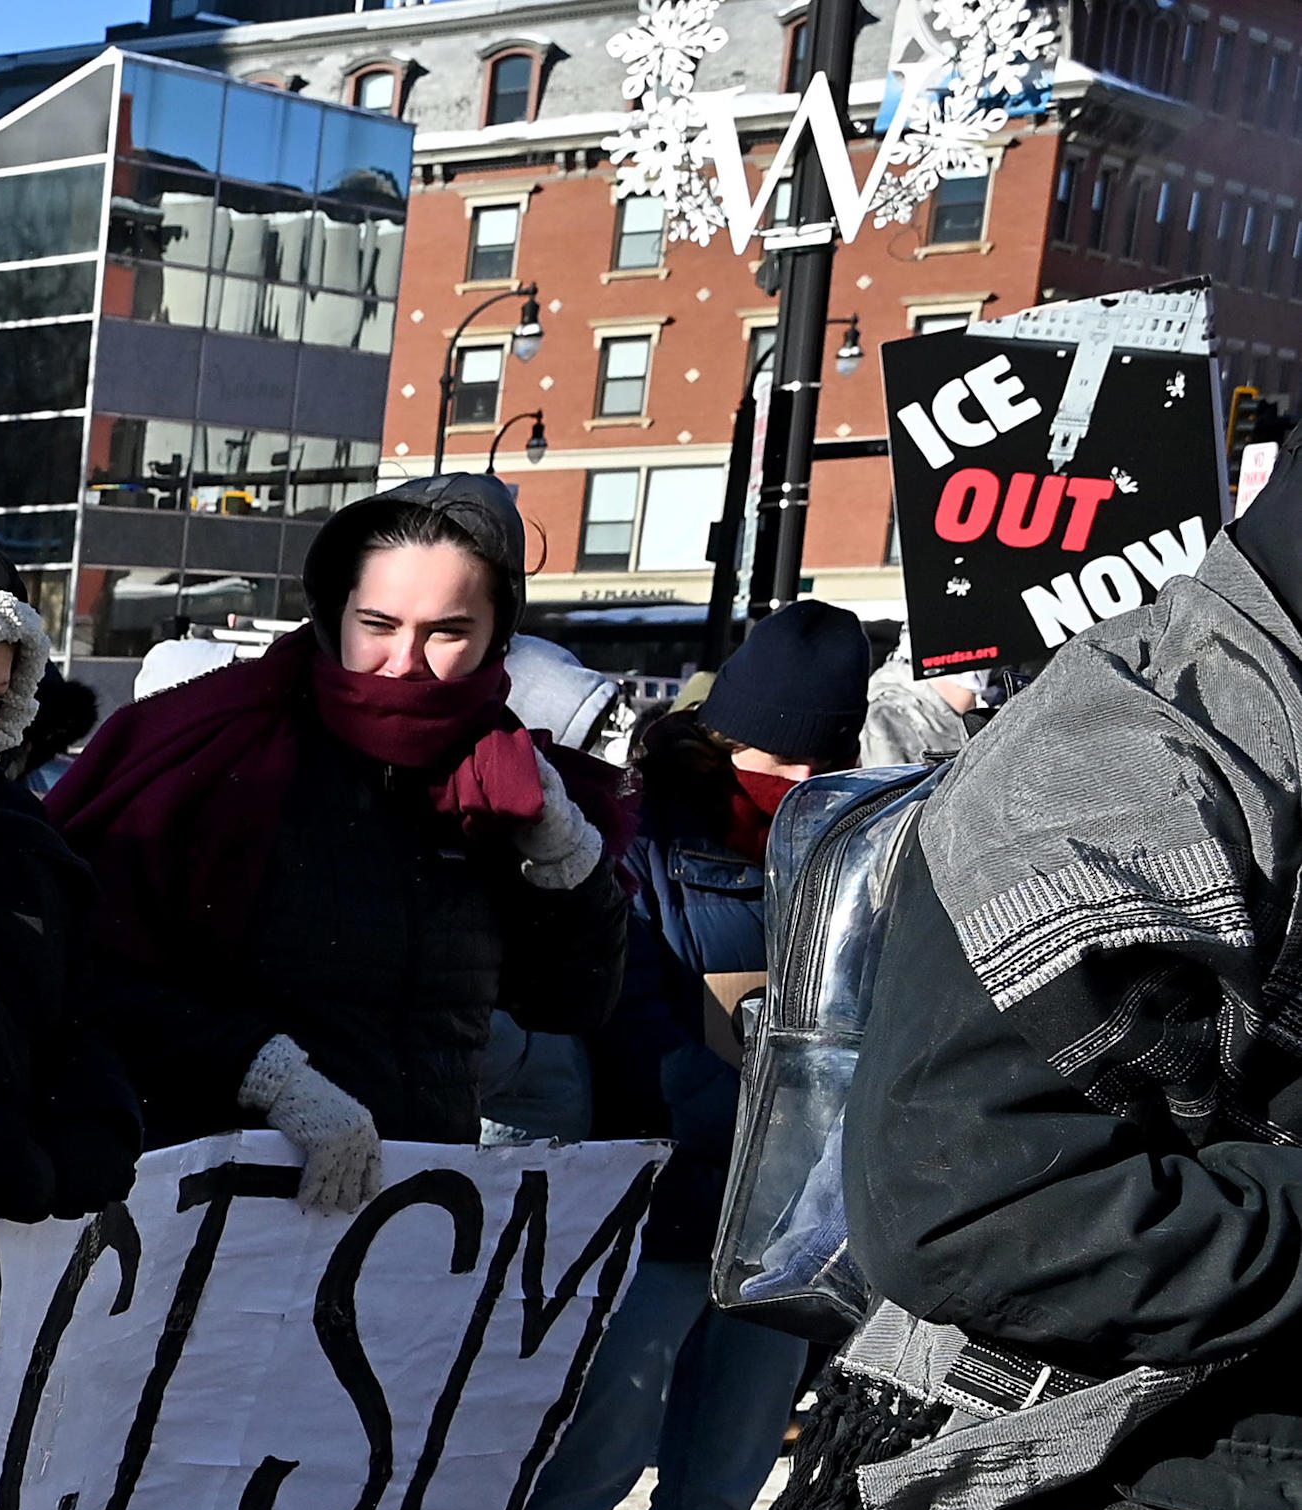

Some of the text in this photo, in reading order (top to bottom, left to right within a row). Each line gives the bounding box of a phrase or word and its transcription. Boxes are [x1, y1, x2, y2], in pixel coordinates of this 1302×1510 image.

[897, 353, 1042, 470] ICE
[934, 467, 1116, 552] OUT
[1021, 516, 1208, 649] NOW
